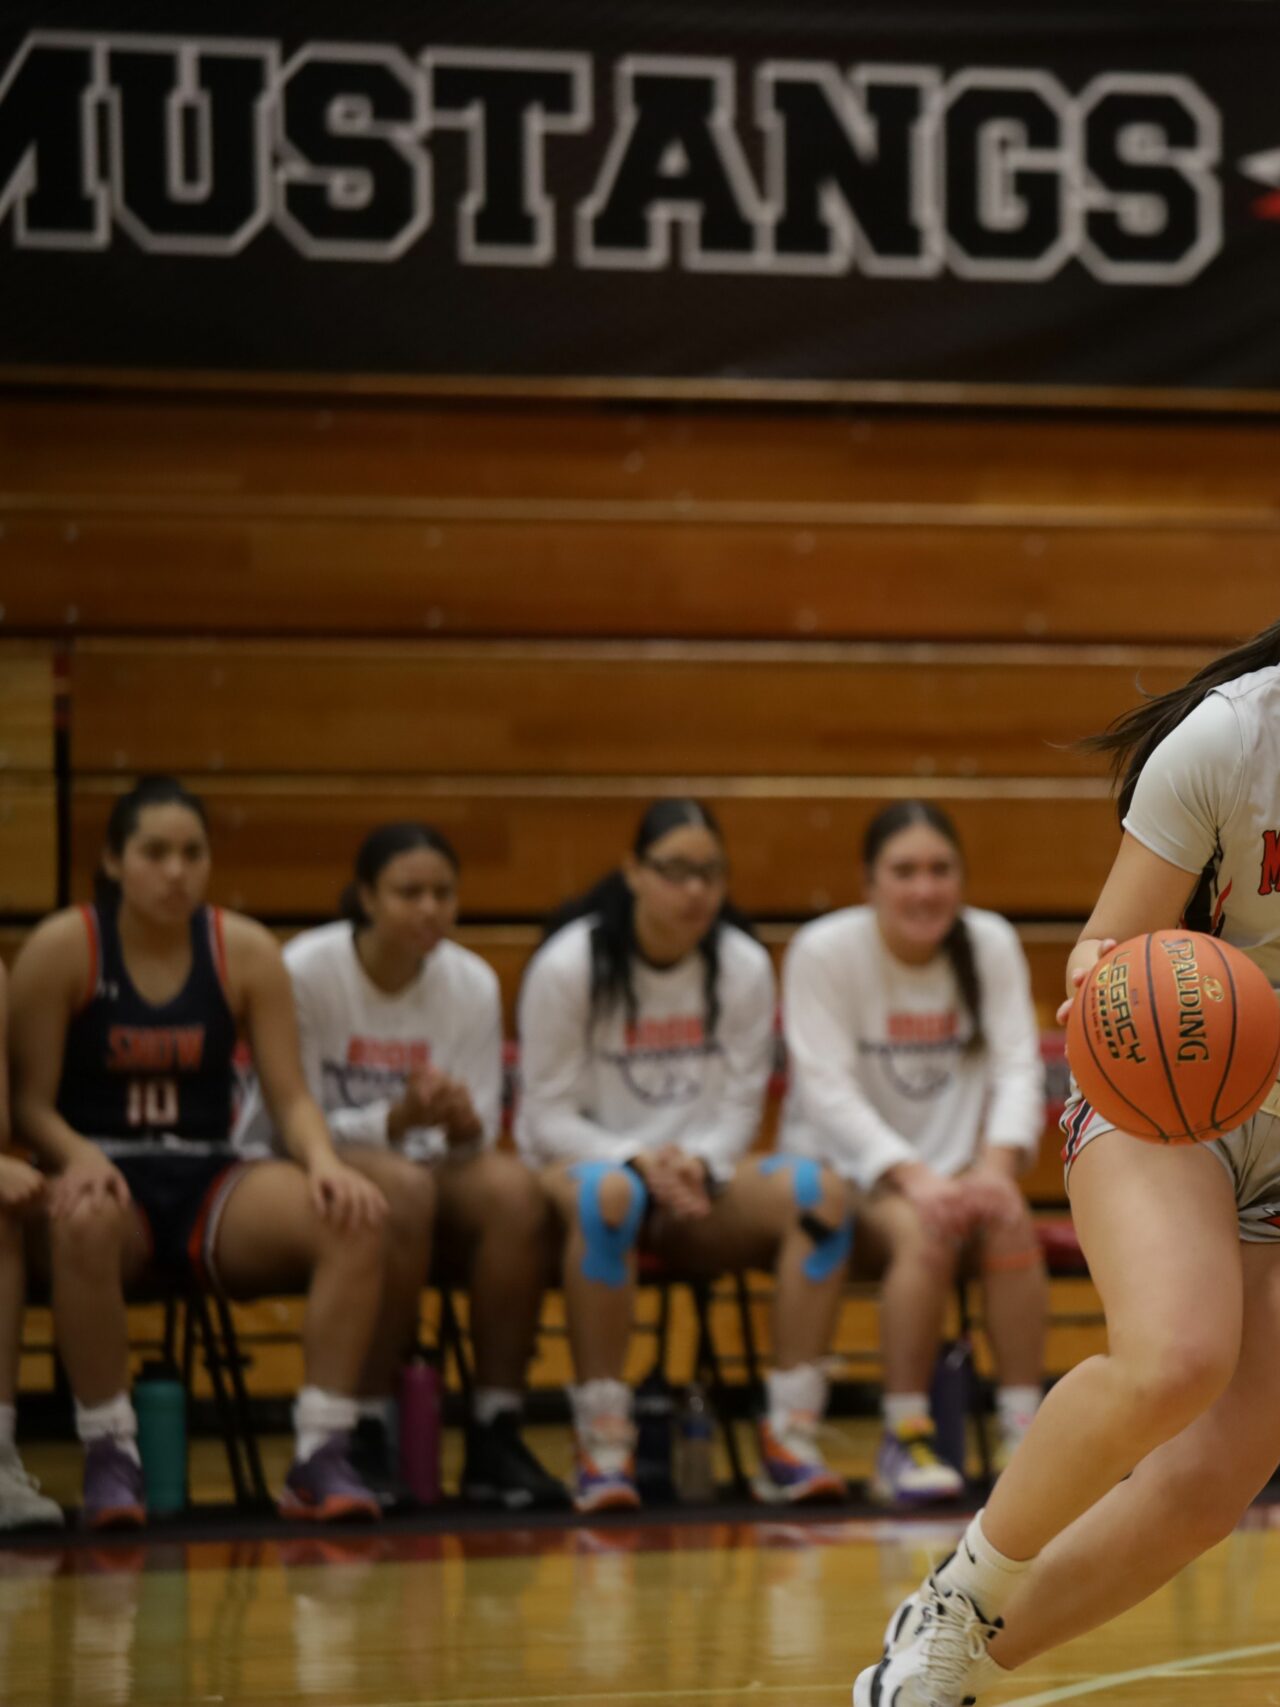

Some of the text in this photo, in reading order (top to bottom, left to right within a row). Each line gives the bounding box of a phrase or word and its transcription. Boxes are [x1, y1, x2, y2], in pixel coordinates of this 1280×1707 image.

[1110, 950, 1146, 1064] LEGACY
[1161, 938, 1210, 1063] SPALDING
[127, 1080, 180, 1127] 10
